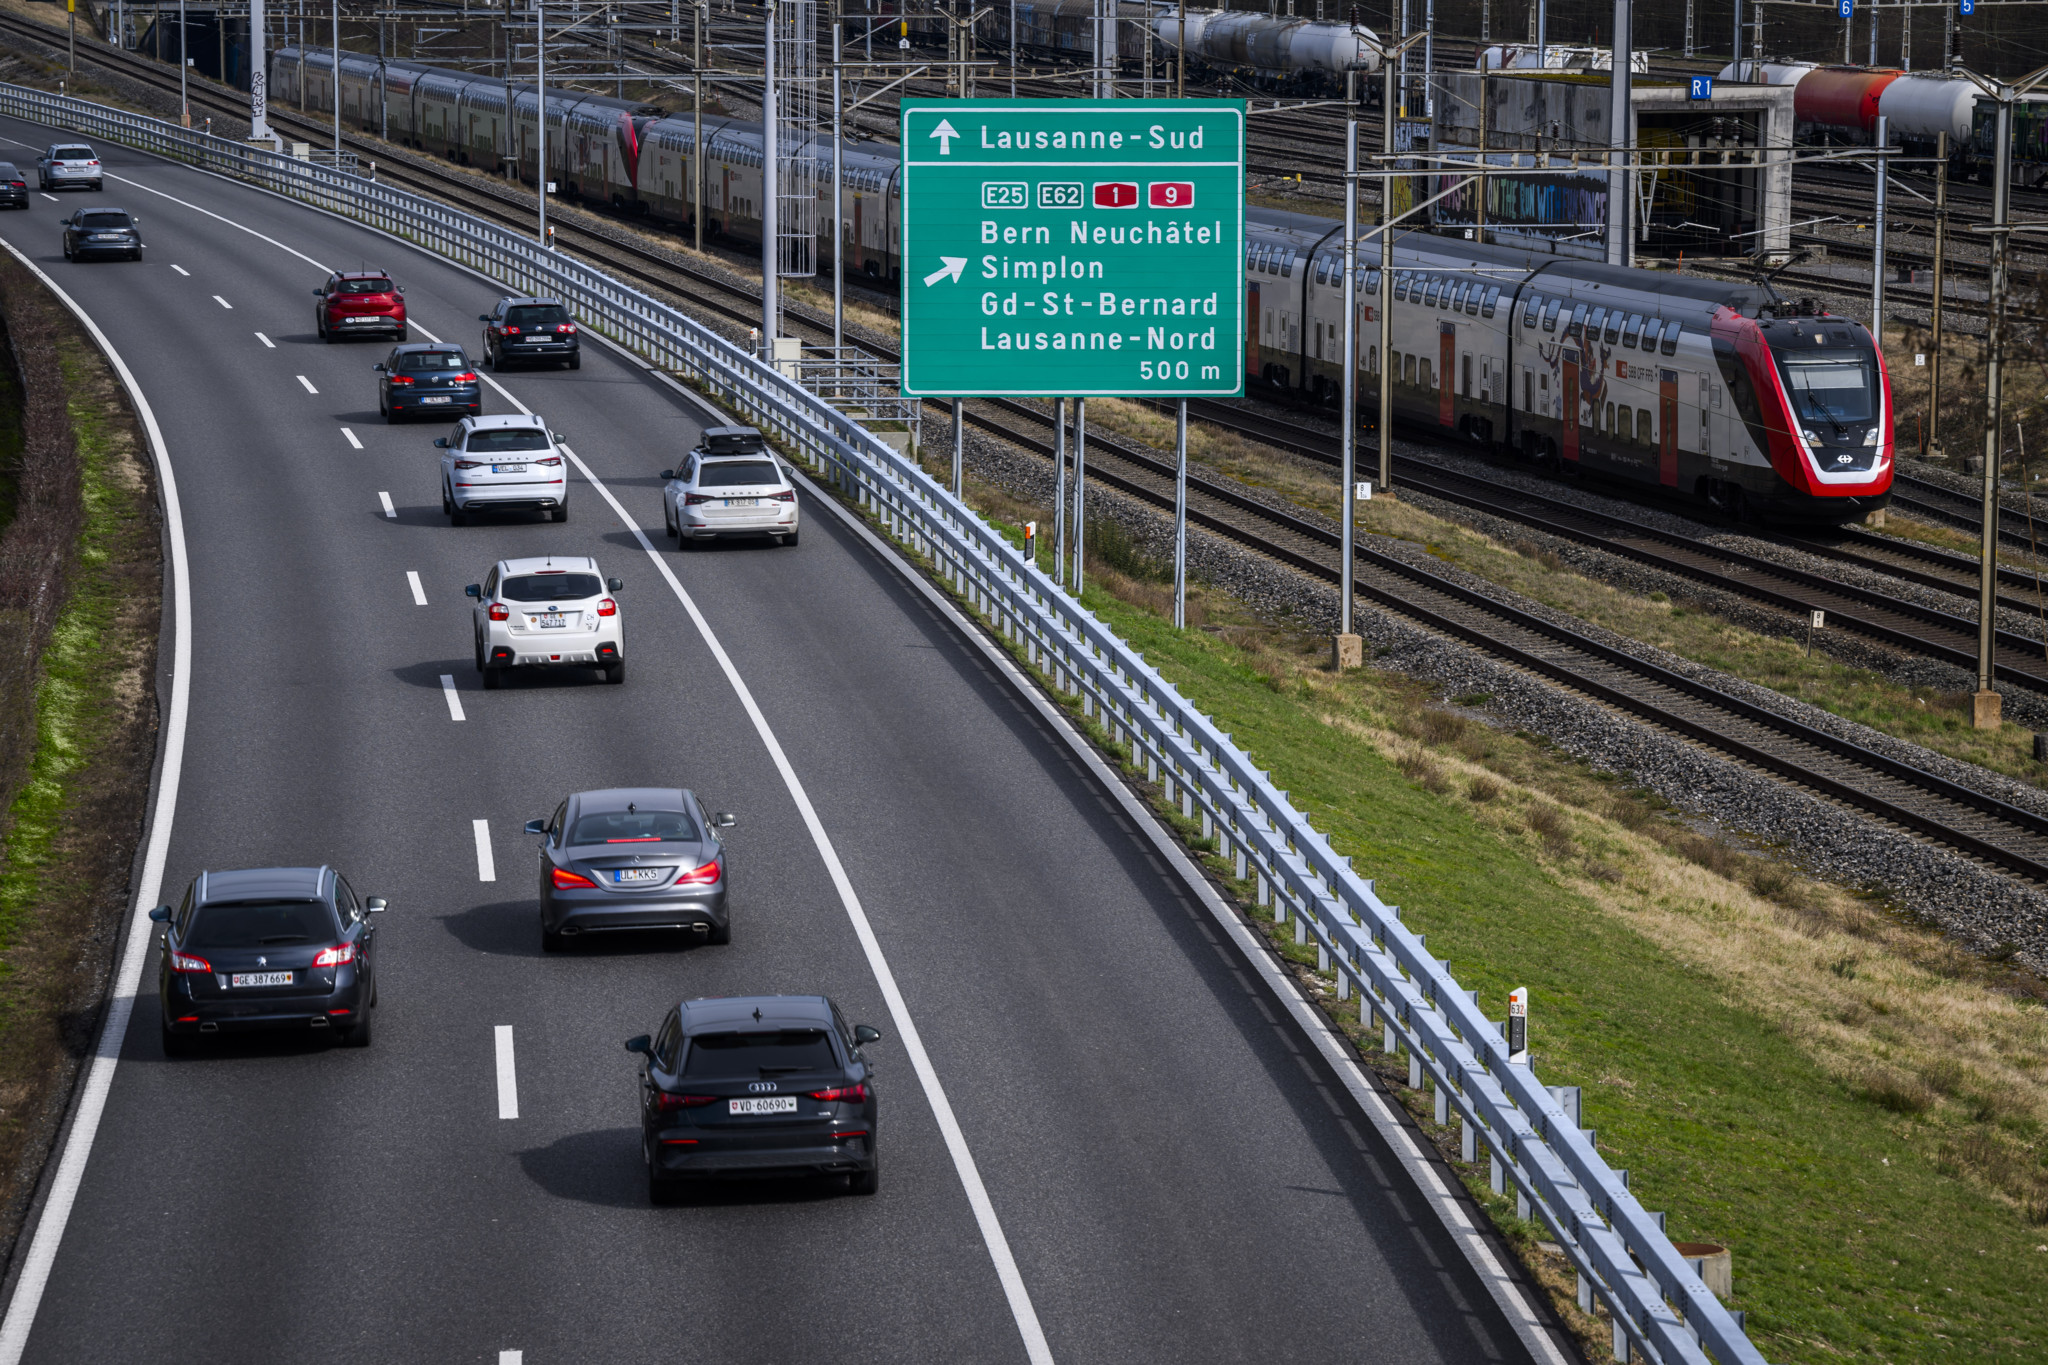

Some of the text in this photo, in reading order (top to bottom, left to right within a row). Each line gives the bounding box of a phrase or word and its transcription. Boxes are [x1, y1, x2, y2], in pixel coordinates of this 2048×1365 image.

[1842, 0, 1850, 14] 6
[1963, 0, 1971, 12] 5
[1692, 79, 1710, 96] R 1
[982, 125, 1202, 149] Lausanne-Sud
[987, 187, 1177, 203] E25 E62 1 9
[982, 221, 1220, 244] Bern Neuchâtel
[982, 255, 1102, 284] Simplon
[982, 292, 1216, 315] Gd-St-Bernard
[982, 327, 1214, 350] Lausanne-Nord
[1141, 361, 1219, 379] 500 m
[620, 870, 633, 880] UL
